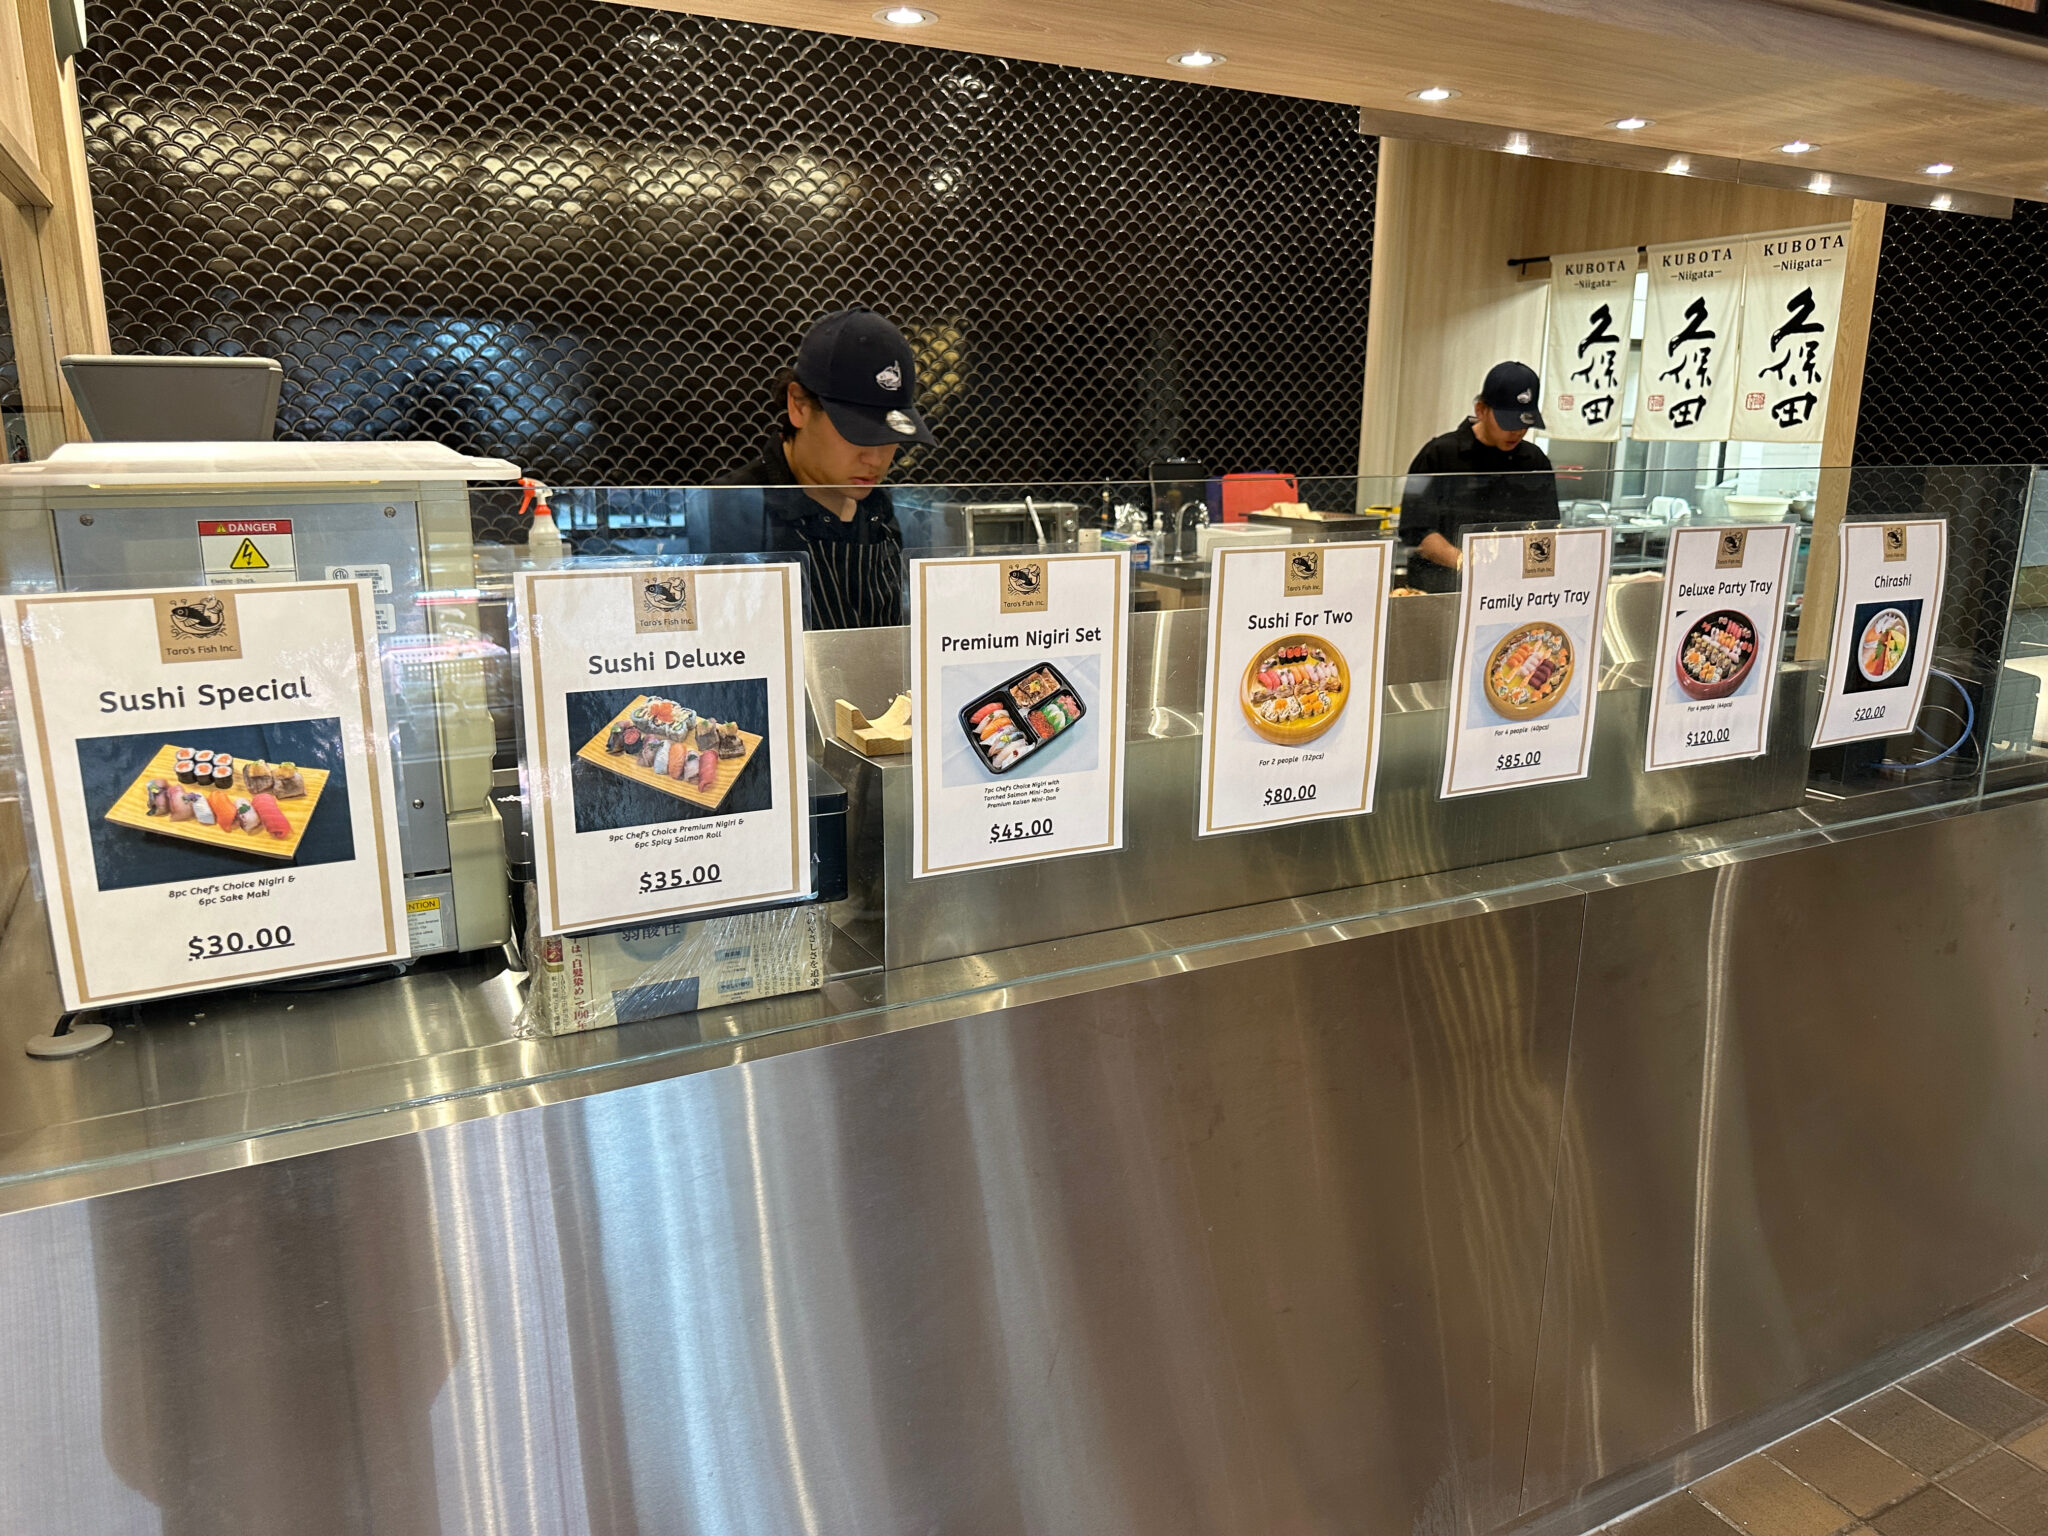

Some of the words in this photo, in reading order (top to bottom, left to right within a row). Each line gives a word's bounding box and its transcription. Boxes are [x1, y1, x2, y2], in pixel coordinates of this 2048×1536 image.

[1764, 235, 1844, 257] KUBOTA
[1565, 260, 1625, 275] KUBOTA
[1662, 248, 1732, 267] KUBOTA
[1570, 303, 1620, 425] 久保田
[1659, 296, 1716, 429] 久保田
[1758, 286, 1825, 428] 久保田
[228, 522, 277, 533] DANGER
[1679, 583, 1715, 597] Deluxe
[1718, 582, 1747, 596] Party
[1750, 580, 1773, 596] Tray
[1874, 574, 1912, 588] Chirashi
[1480, 594, 1523, 611] Family
[1527, 592, 1560, 608] Party
[1564, 590, 1590, 605] Tray
[639, 619, 662, 627] Taro's
[663, 618, 680, 626] Fish
[681, 617, 694, 625] Inc.
[1248, 612, 1289, 630] Sushi
[1295, 612, 1319, 627] For
[1324, 610, 1353, 624] Two
[166, 646, 196, 656] Taro's
[198, 645, 217, 654] Fish
[219, 643, 238, 652] Inc.
[941, 633, 1019, 652] Premium
[1026, 628, 1070, 649] Nigiri
[1075, 627, 1102, 642] Set
[588, 652, 655, 675] Sushi
[665, 648, 746, 670] Deluxe
[100, 685, 186, 714] Sushi
[198, 676, 312, 710] Special
[1853, 705, 1886, 722] $20.00
[1509, 726, 1528, 736] people
[1685, 728, 1730, 747] $120.00
[1277, 756, 1299, 766] people
[1302, 752, 1325, 762] (32pcs)
[1496, 751, 1541, 771] $85.00
[996, 785, 1012, 793] Chef's
[1007, 791, 1027, 799] Salmon
[1263, 784, 1316, 806] $80.00
[609, 834, 624, 842] 9pc
[626, 830, 649, 840] Chef's
[652, 827, 677, 836] Choice
[680, 823, 713, 833] Premium
[716, 818, 736, 829] Nigiri
[634, 841, 649, 849] 6pc
[651, 838, 672, 848] Spicy
[674, 833, 704, 843] Salmon
[706, 831, 722, 839] Roll
[989, 818, 1054, 844] $45.00
[168, 890, 187, 899] 8pc
[190, 884, 220, 896] Chef's
[223, 880, 255, 891] Choice
[258, 876, 285, 888] Nigiri
[288, 875, 296, 883] &
[639, 863, 722, 895] $35.00
[199, 897, 217, 906] 6pc
[220, 893, 244, 903] Sake
[246, 889, 270, 899] Maki
[188, 925, 295, 961] $30.00
